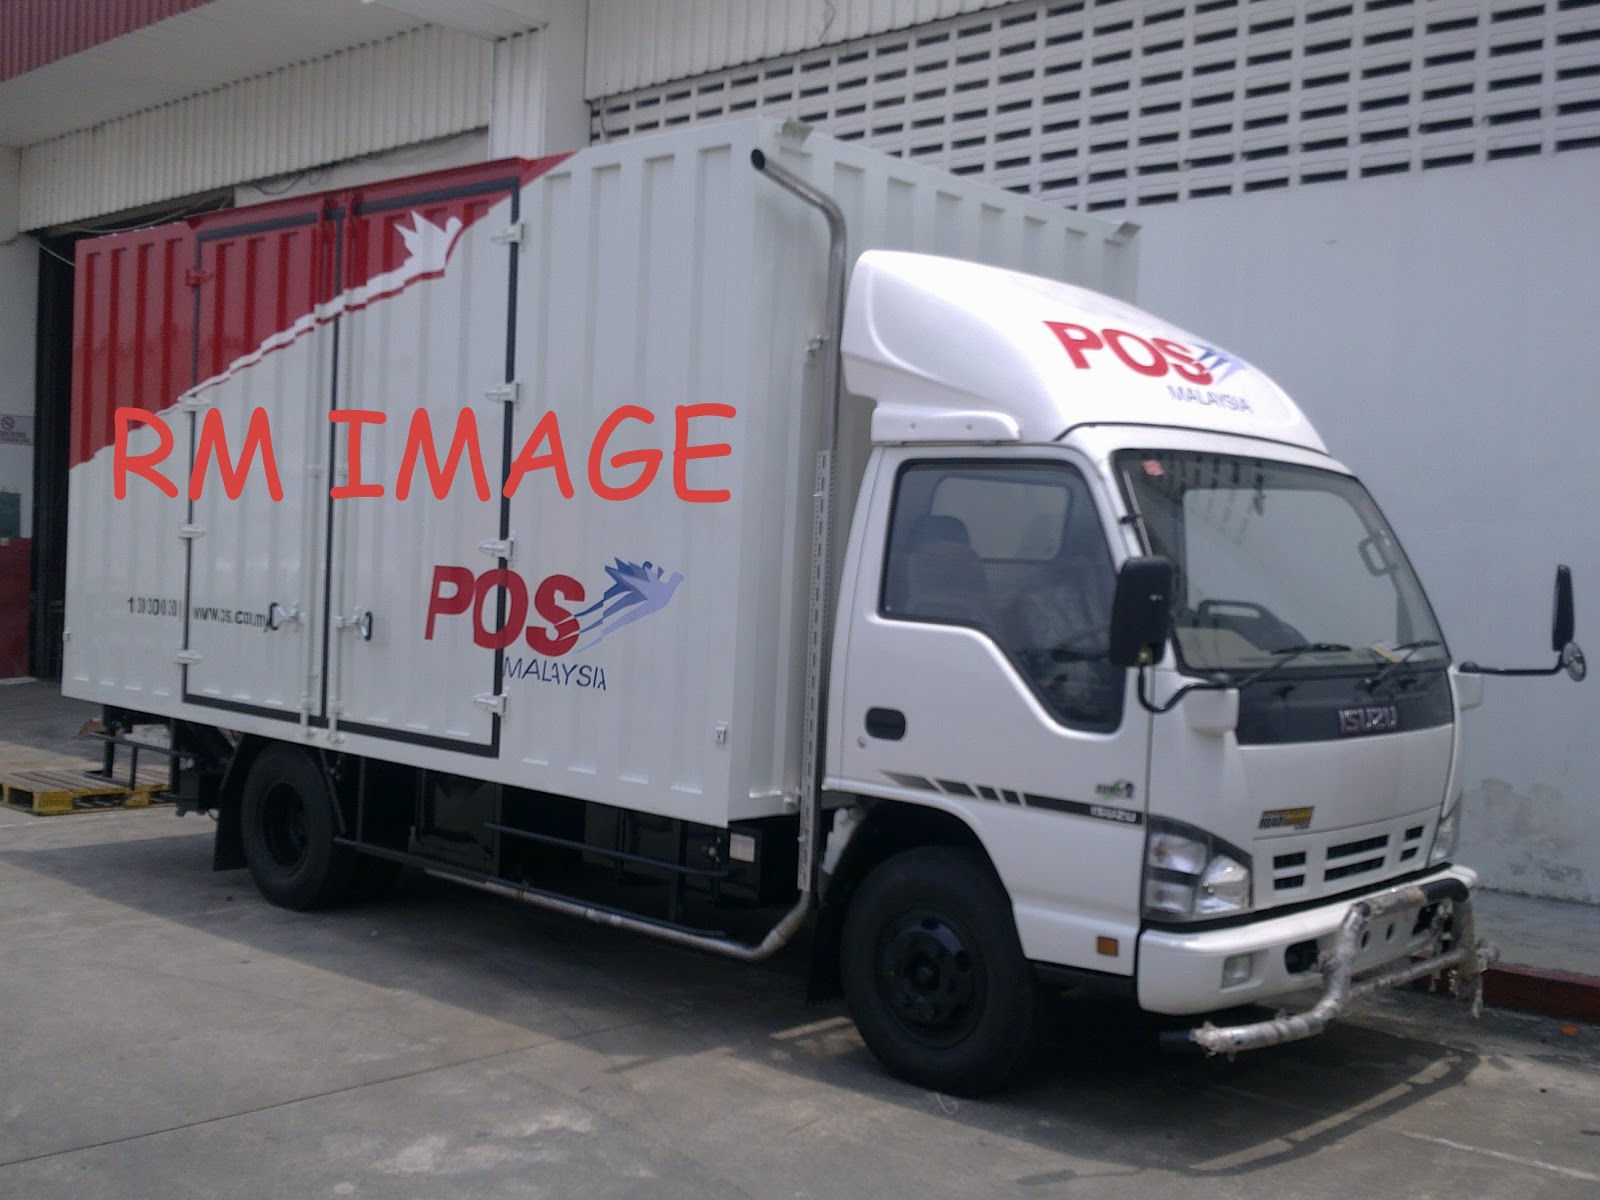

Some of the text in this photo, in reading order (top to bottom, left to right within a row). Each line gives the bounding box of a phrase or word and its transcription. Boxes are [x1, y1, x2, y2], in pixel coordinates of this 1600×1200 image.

[1042, 320, 1213, 386] POS
[1166, 385, 1252, 413] MALAYSIA
[424, 565, 585, 657] POS
[502, 657, 607, 691] MALAYSIA
[1338, 705, 1398, 734] ISUZU
